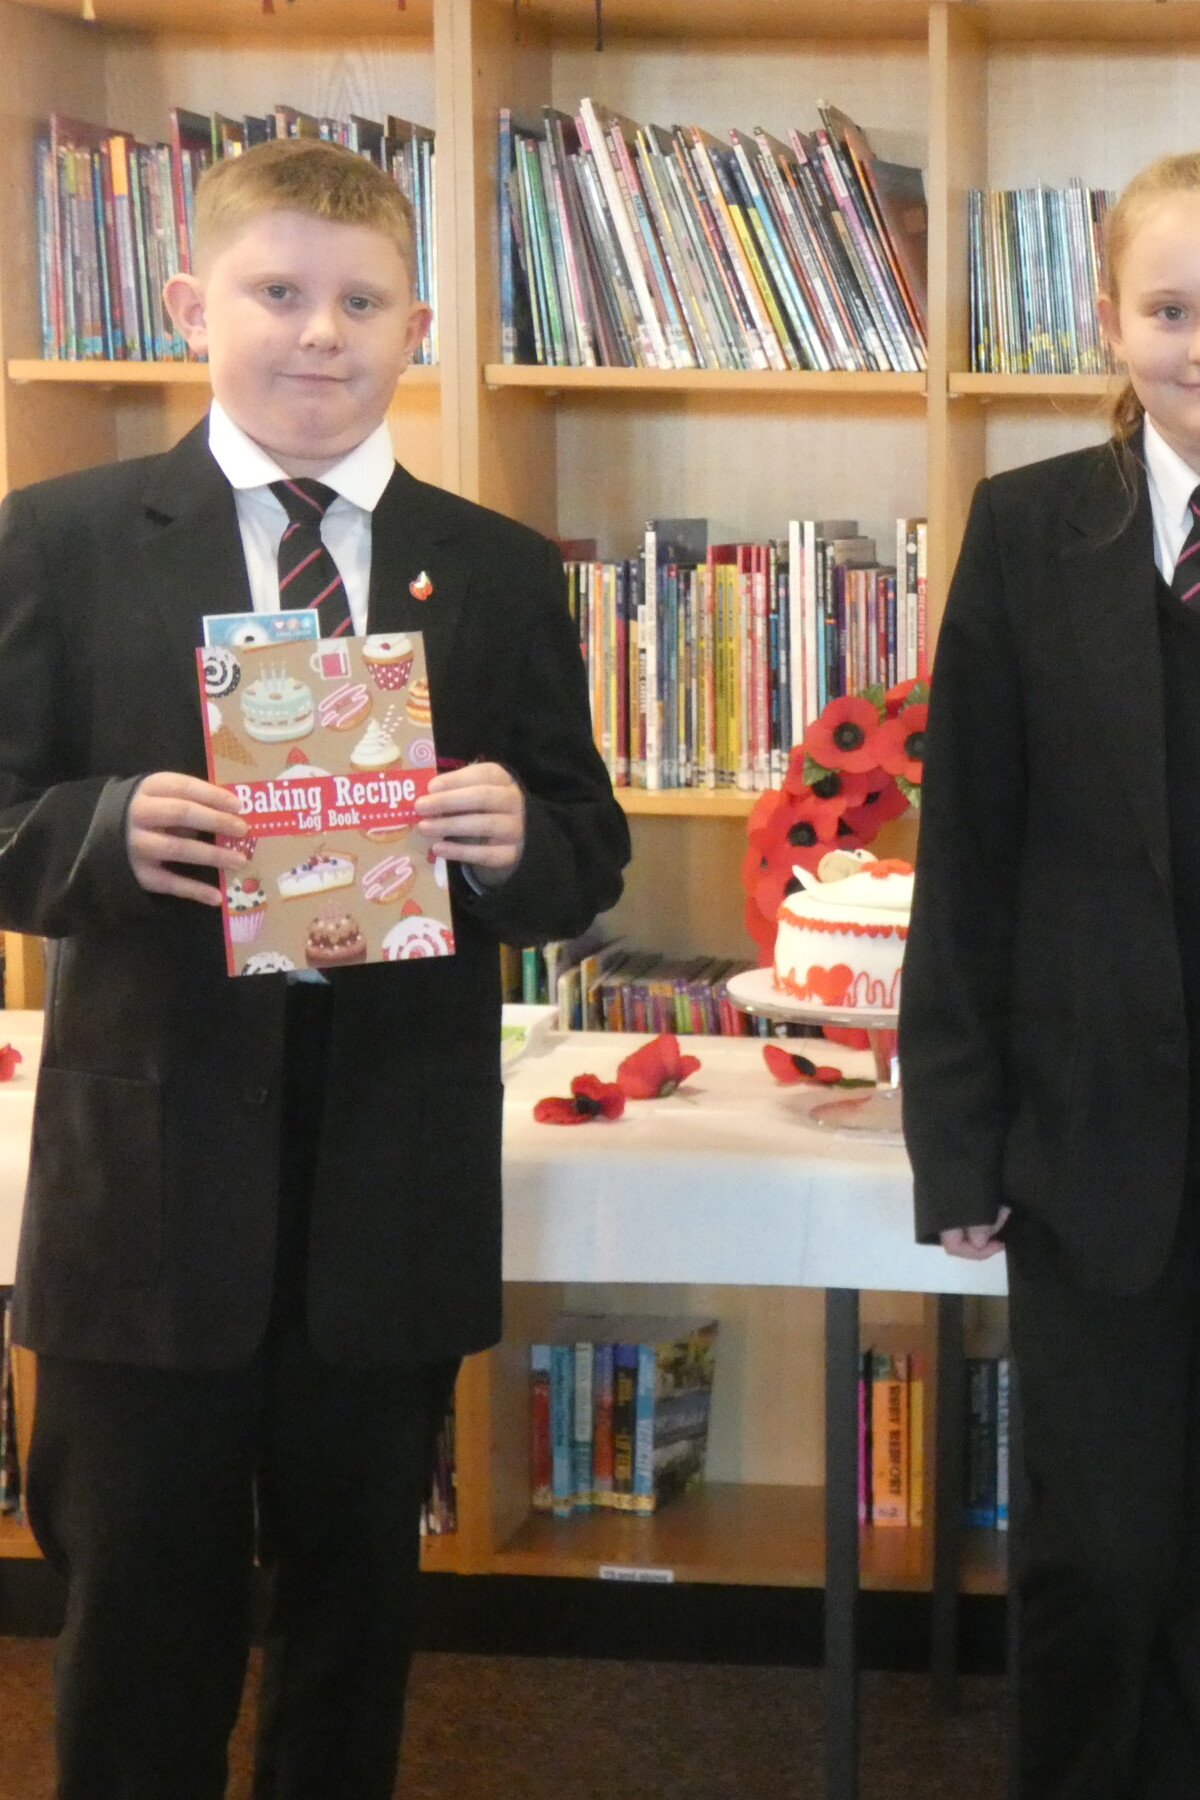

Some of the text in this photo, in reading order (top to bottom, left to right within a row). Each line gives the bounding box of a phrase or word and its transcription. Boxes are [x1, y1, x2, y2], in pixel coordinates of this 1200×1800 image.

[235, 773, 416, 815] Baking Recipe
[298, 809, 360, 831] Log Book
